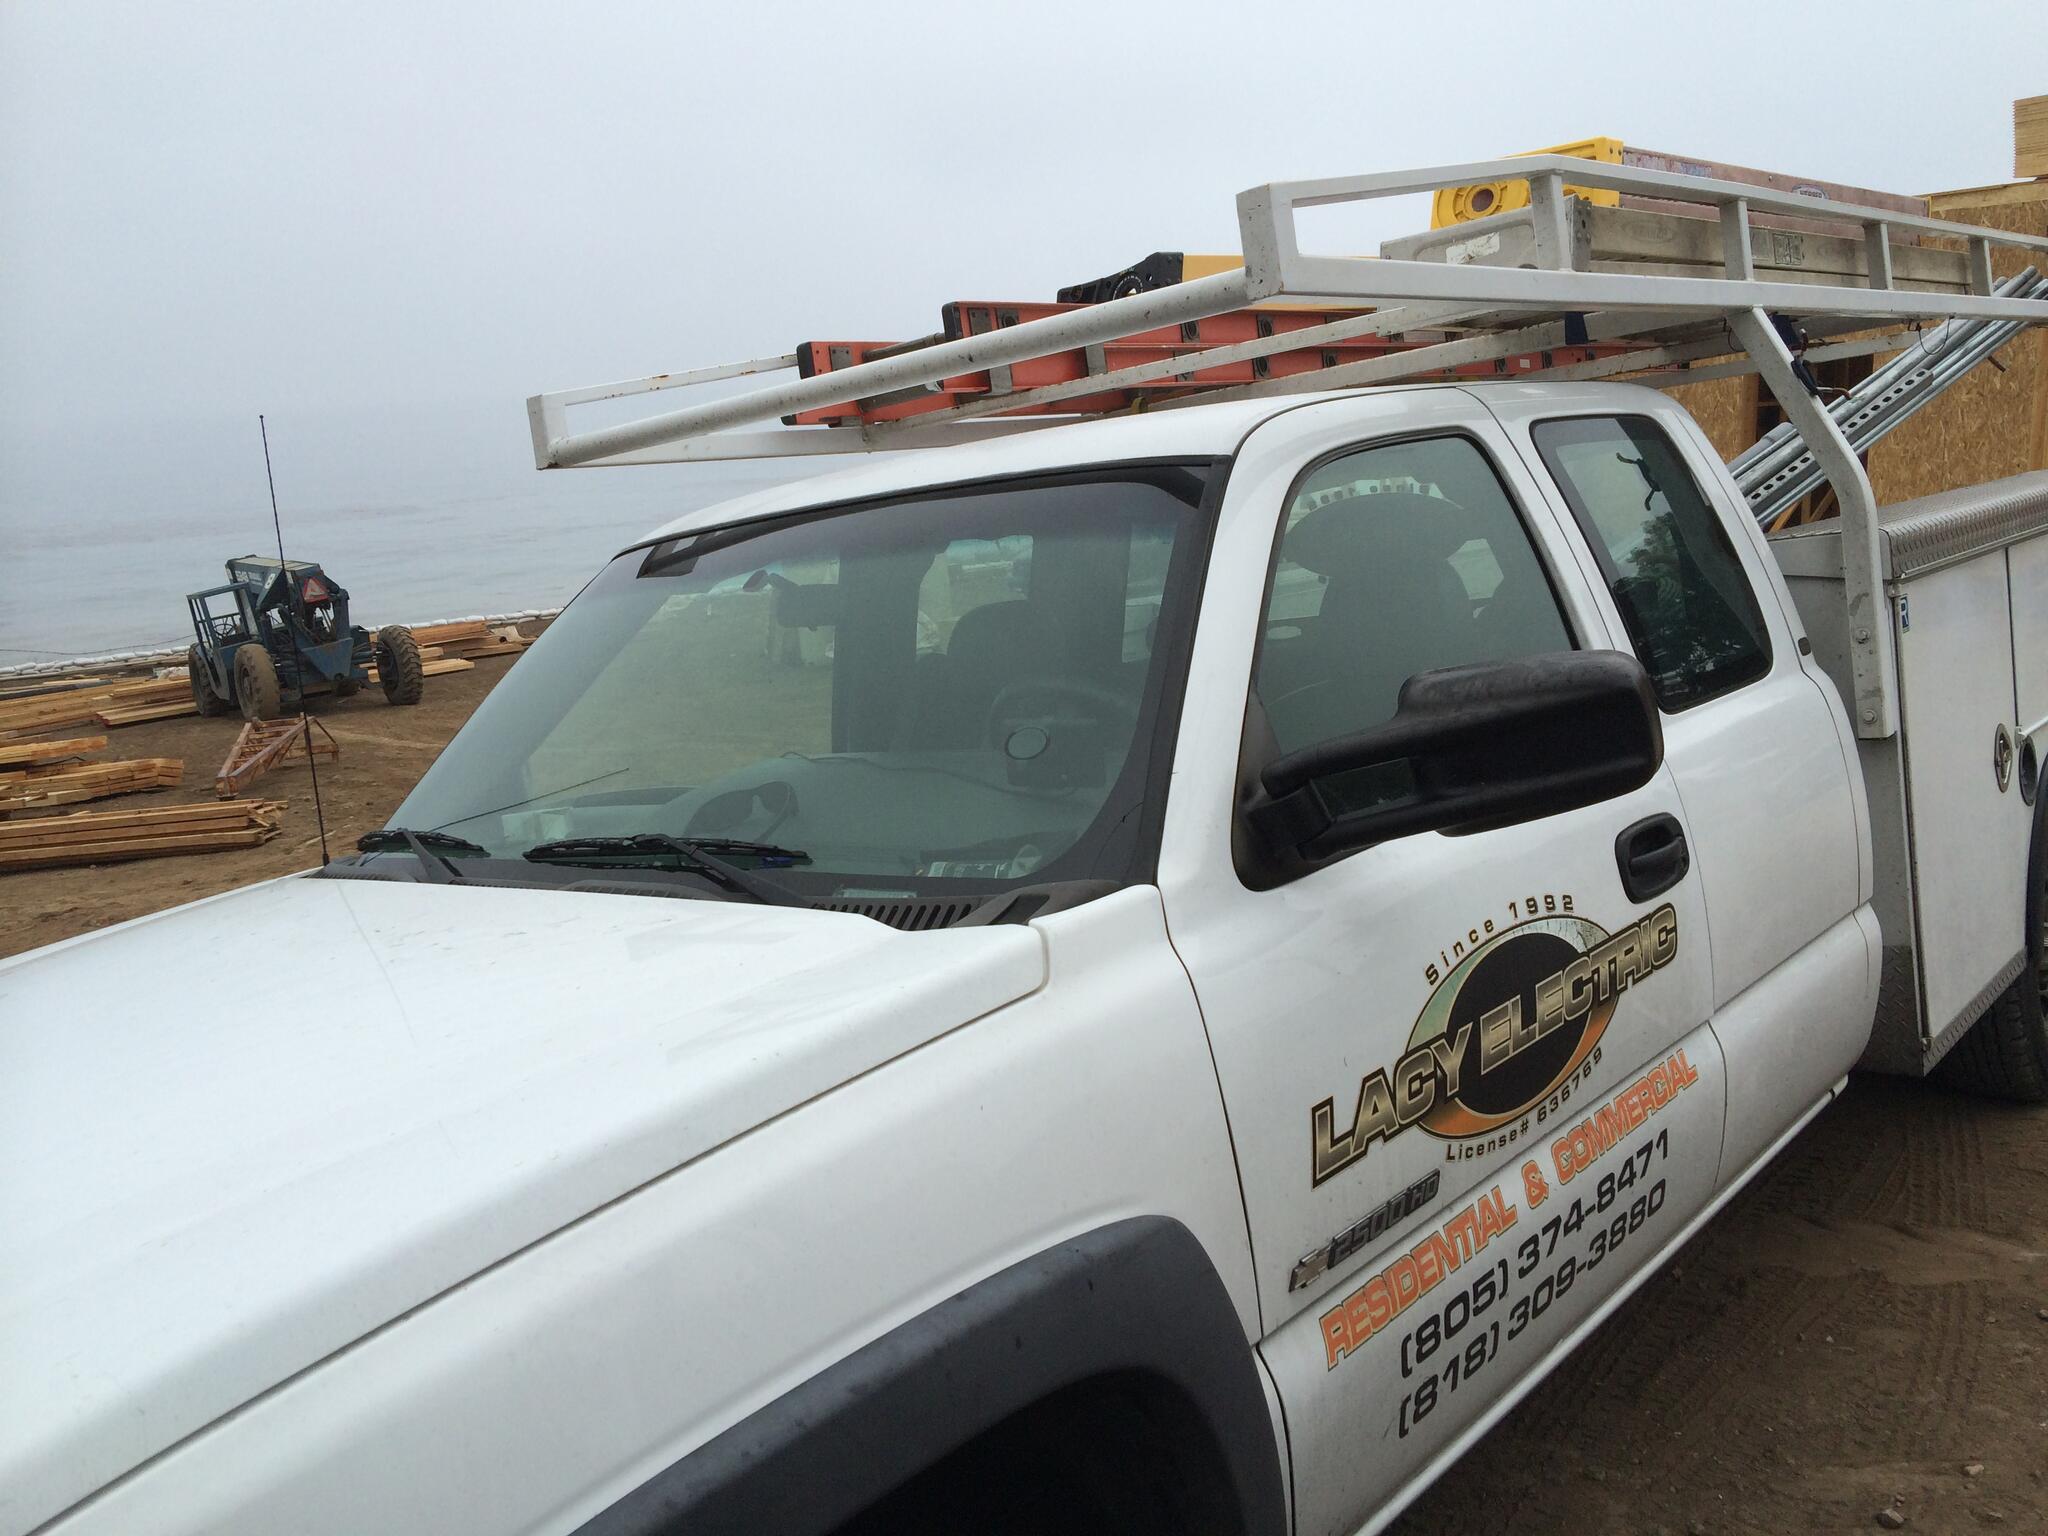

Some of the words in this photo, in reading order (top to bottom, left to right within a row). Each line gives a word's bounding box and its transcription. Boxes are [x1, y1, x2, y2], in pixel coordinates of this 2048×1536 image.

[1312, 1022, 1472, 1188] LACY
[1479, 902, 1678, 1076] ELECTRIC
[1425, 919, 1494, 986] Since
[1509, 894, 1574, 919] 1992
[1320, 1186, 1518, 1371] RESIDENTIAL
[1521, 1160, 1550, 1209] &
[1551, 1048, 1698, 1185] COMMERCIAL
[1446, 1118, 1529, 1161] License#
[1537, 1047, 1602, 1124] 636769
[1399, 1320, 1499, 1438] (818)
[1508, 1178, 1666, 1341] 309-3880
[1401, 1258, 1508, 1378] (805)
[1518, 1128, 1668, 1279] 374-8471
